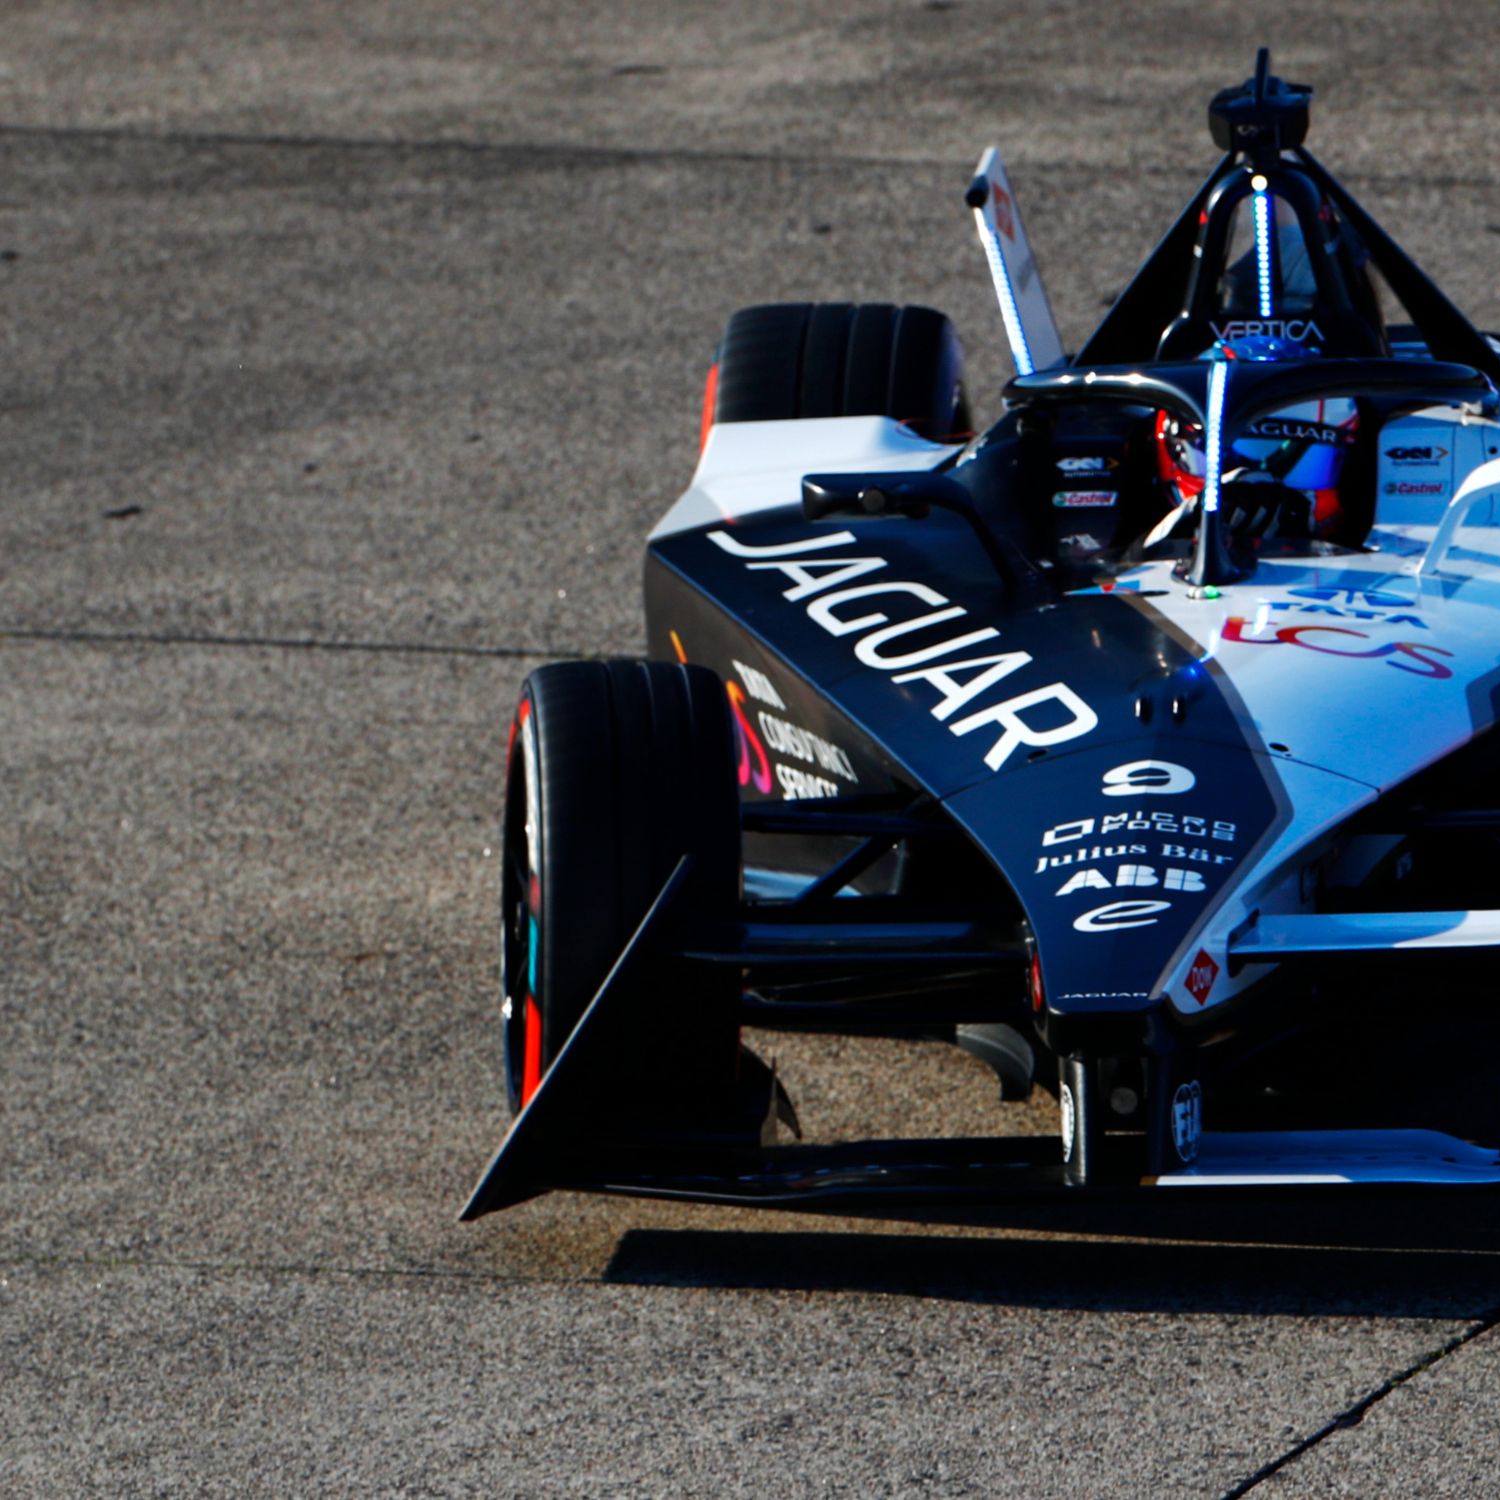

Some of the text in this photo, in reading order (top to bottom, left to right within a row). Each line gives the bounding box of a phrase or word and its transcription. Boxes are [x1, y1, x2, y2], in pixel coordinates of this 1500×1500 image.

[1248, 422, 1338, 443] AGUAR
[706, 530, 1099, 772] JAGUAR
[1102, 760, 1196, 797] 9
[1101, 820, 1235, 842] FOCUS
[1103, 811, 1236, 833] MICRO
[1034, 843, 1148, 874] Julius
[1055, 864, 1207, 897] ABB
